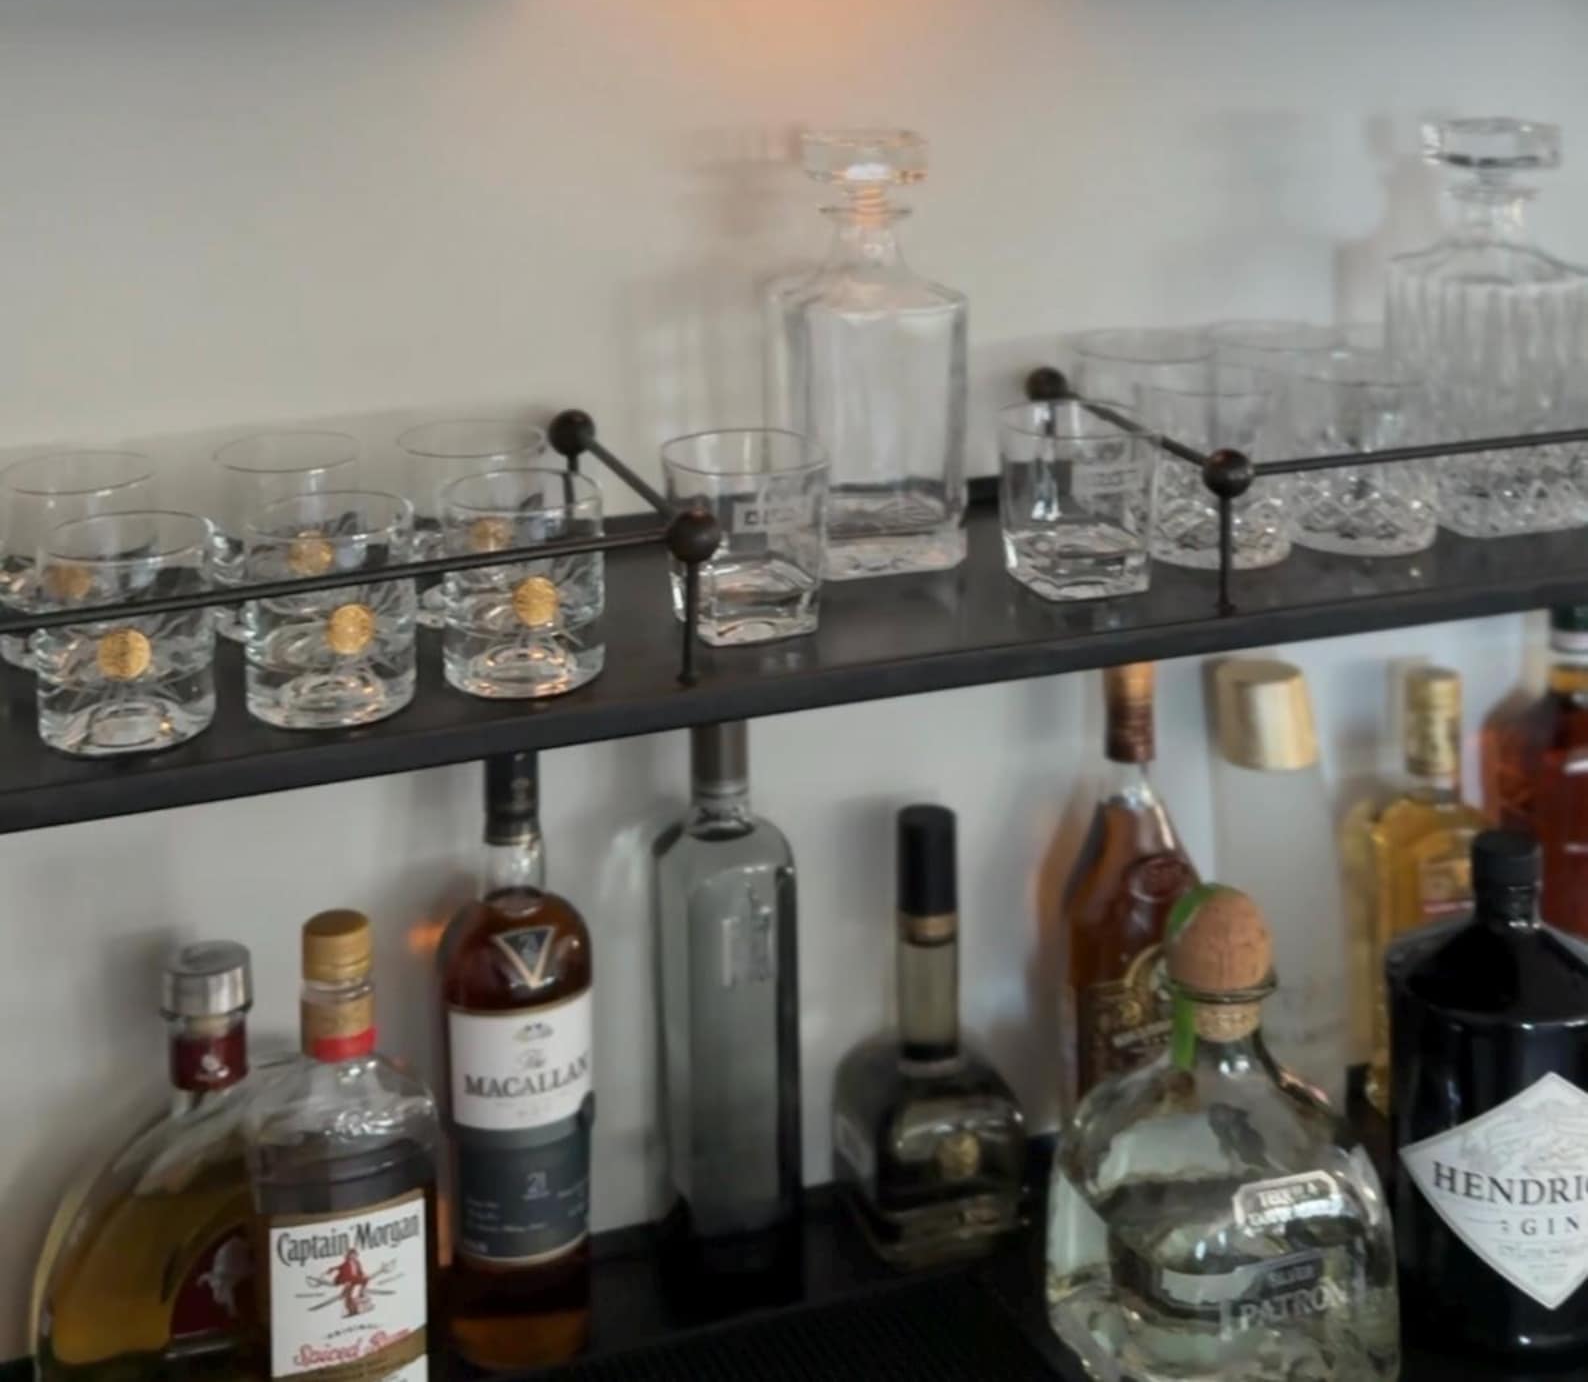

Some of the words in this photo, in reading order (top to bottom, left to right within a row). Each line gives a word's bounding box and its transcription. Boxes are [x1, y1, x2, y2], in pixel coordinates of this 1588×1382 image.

[463, 1050, 589, 1098] MACALLAN
[1432, 1161, 1588, 1205] HENDRI
[276, 1226, 349, 1268] Captain
[351, 1214, 420, 1250] Morgan
[1519, 1216, 1580, 1236] GIN
